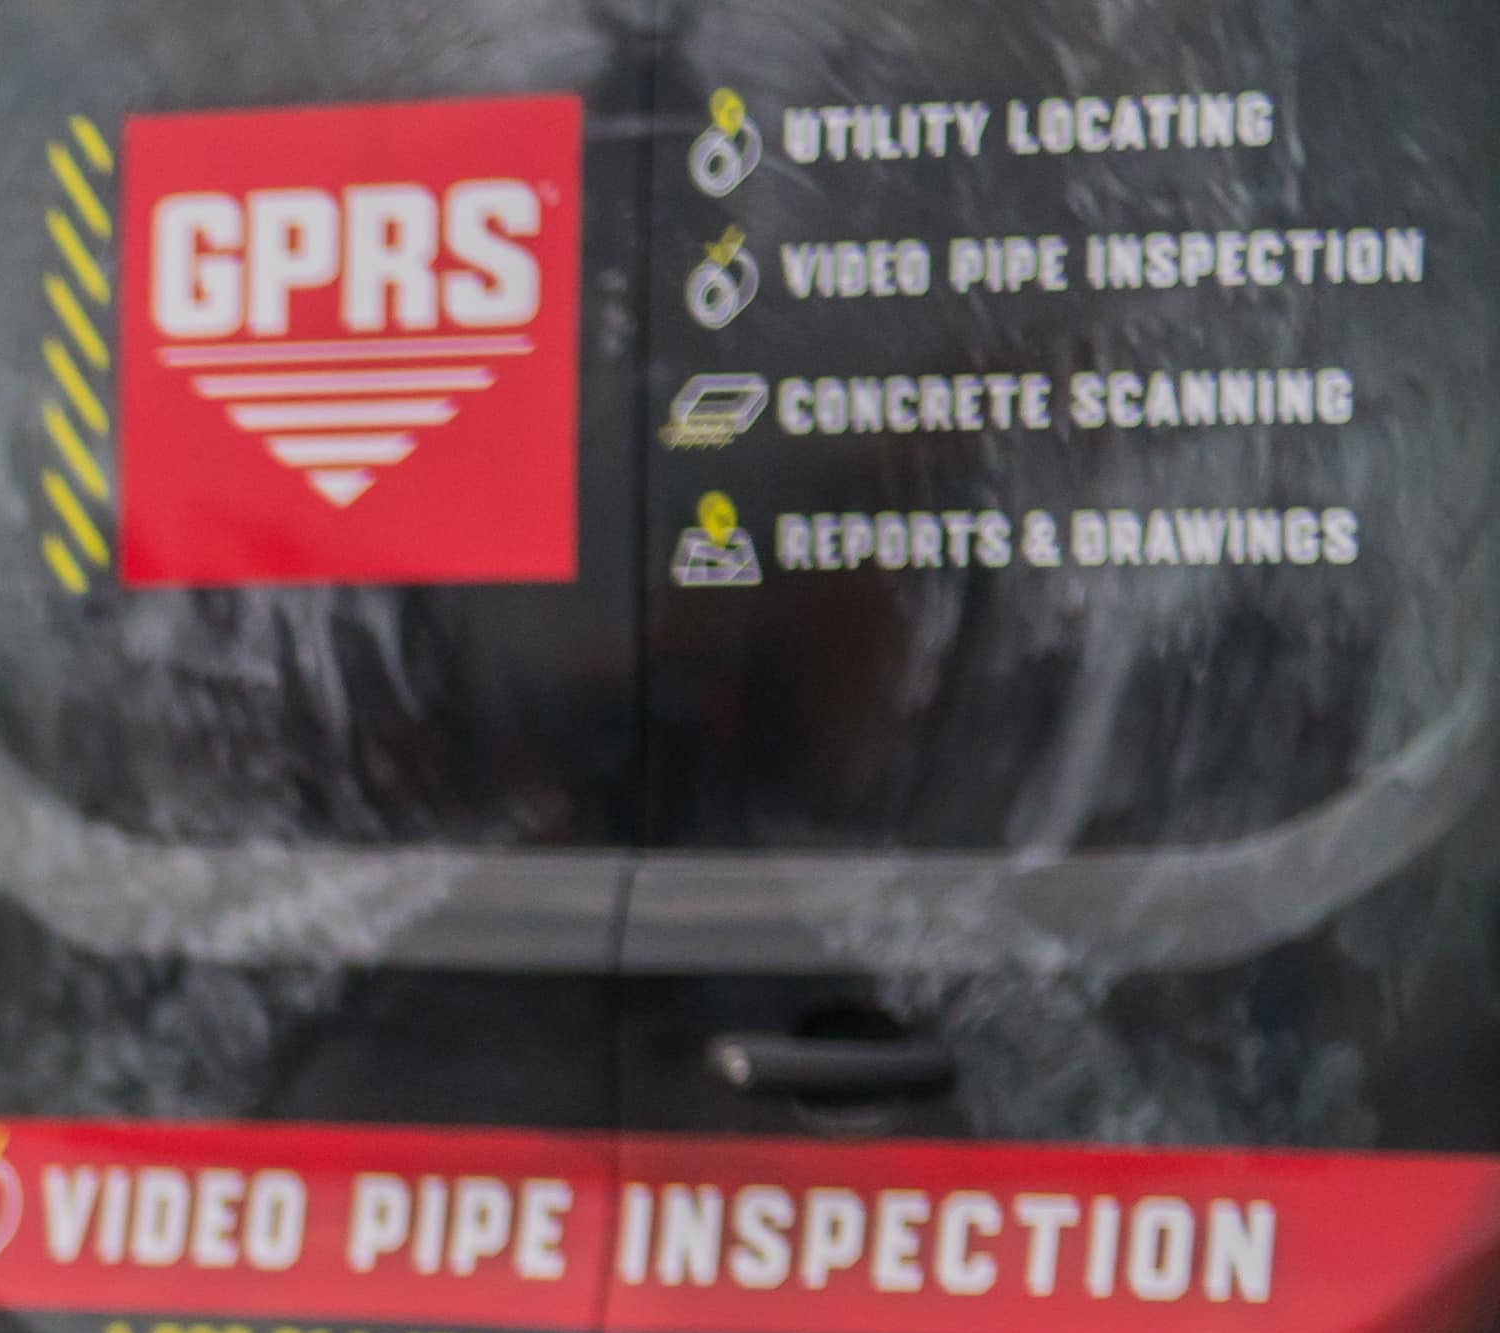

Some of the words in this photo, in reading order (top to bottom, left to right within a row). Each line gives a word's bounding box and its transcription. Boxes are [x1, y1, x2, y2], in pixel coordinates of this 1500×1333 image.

[783, 100, 989, 163] UTILITY
[1008, 91, 1275, 157] LOCATING
[151, 178, 542, 339] GPRS
[780, 238, 930, 300] VIDEO
[950, 234, 1069, 294] PIPE
[1087, 228, 1425, 291] INSPECTION
[776, 374, 1052, 435] CONCRETE
[1070, 367, 1354, 430] SCANNING
[774, 511, 1011, 571] REPORTS
[1021, 510, 1062, 569] &
[1070, 507, 1359, 567] DRAWINGS
[41, 1162, 308, 1271] VIDEO
[347, 1171, 574, 1281] PIPE
[616, 1181, 1277, 1304] INSPECTION
